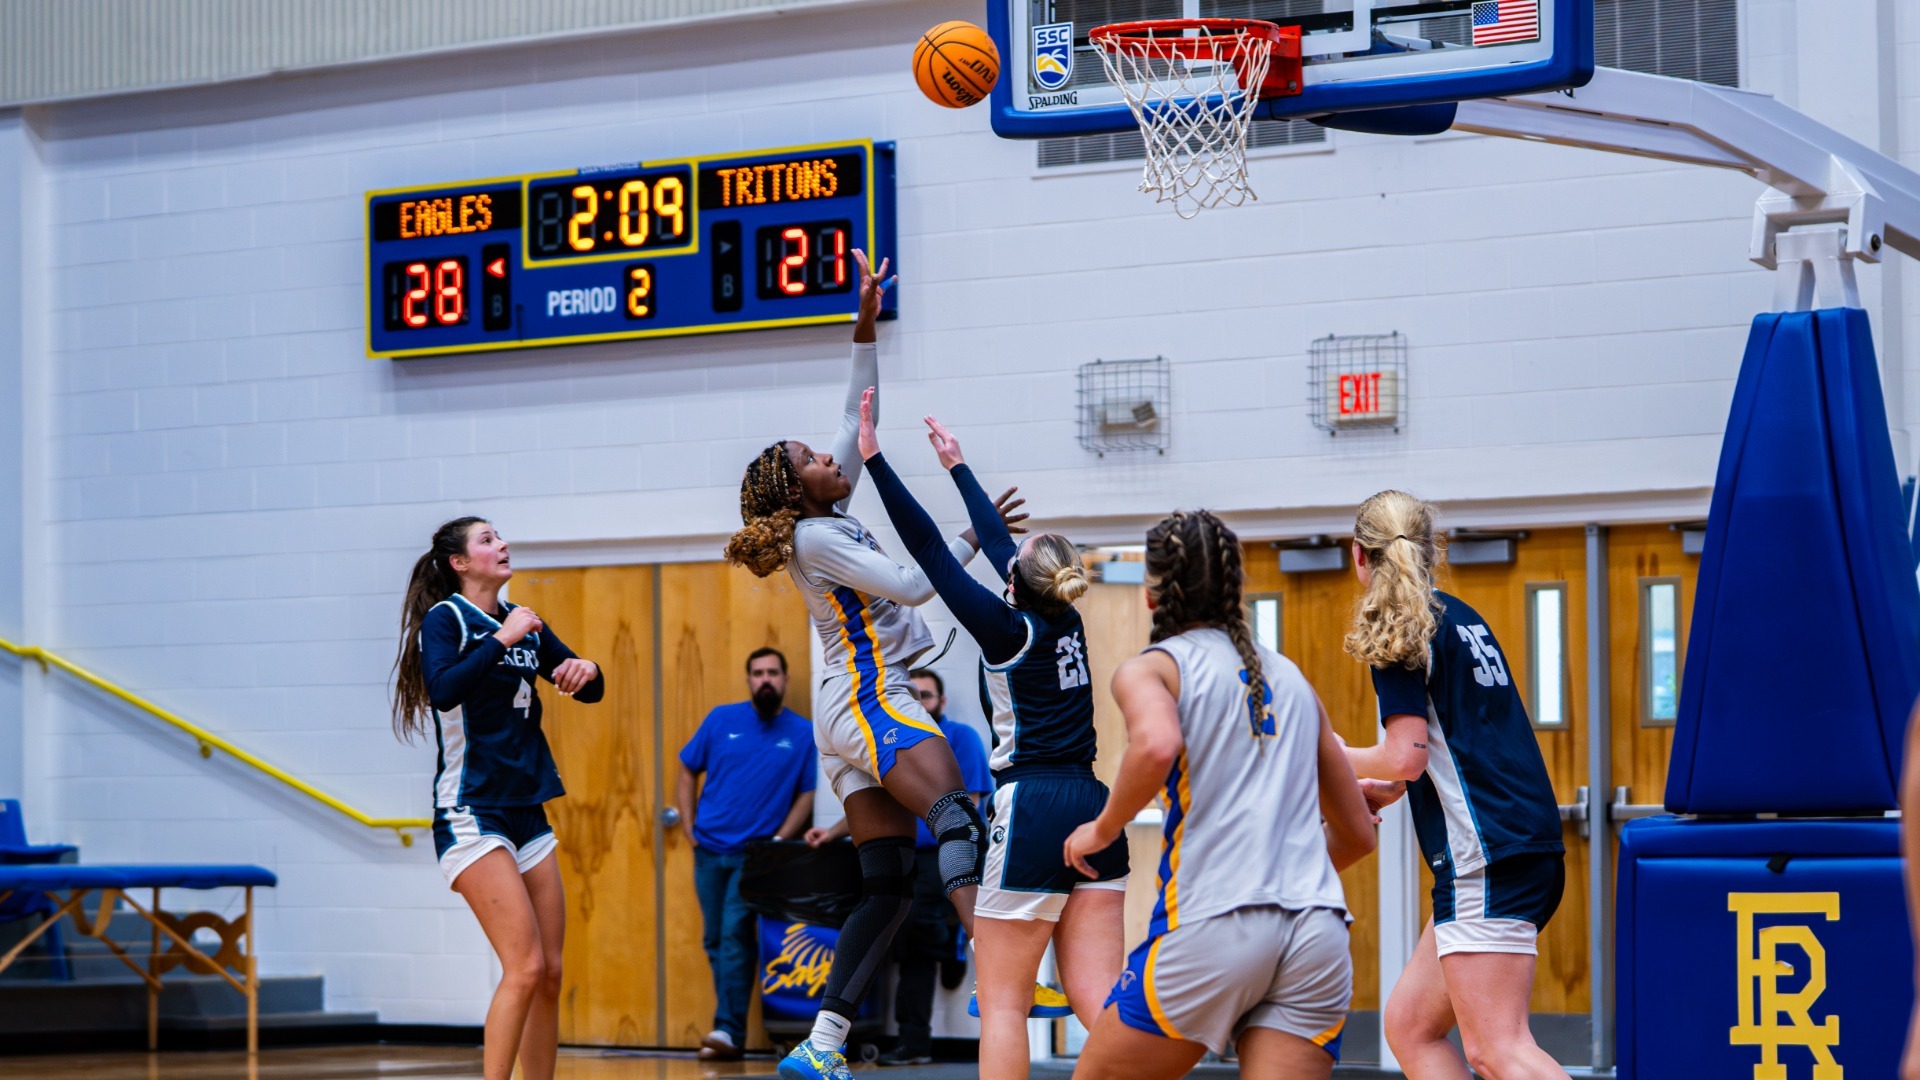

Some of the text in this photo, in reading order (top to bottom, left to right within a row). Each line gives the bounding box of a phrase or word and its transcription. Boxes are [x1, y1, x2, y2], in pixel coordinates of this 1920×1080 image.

[1036, 28, 1069, 46] SSC
[1028, 90, 1078, 110] SPALDING
[716, 158, 838, 206] TRITONS
[400, 194, 493, 239] EAGLES
[568, 176, 684, 252] 2:09
[778, 228, 846, 295] 21
[402, 259, 463, 327] 28
[547, 285, 617, 317] PERIOD
[628, 267, 651, 317] 2
[1339, 372, 1382, 415] EXIT
[1055, 631, 1089, 691] 21
[1455, 624, 1509, 687] 35
[513, 676, 532, 719] 4
